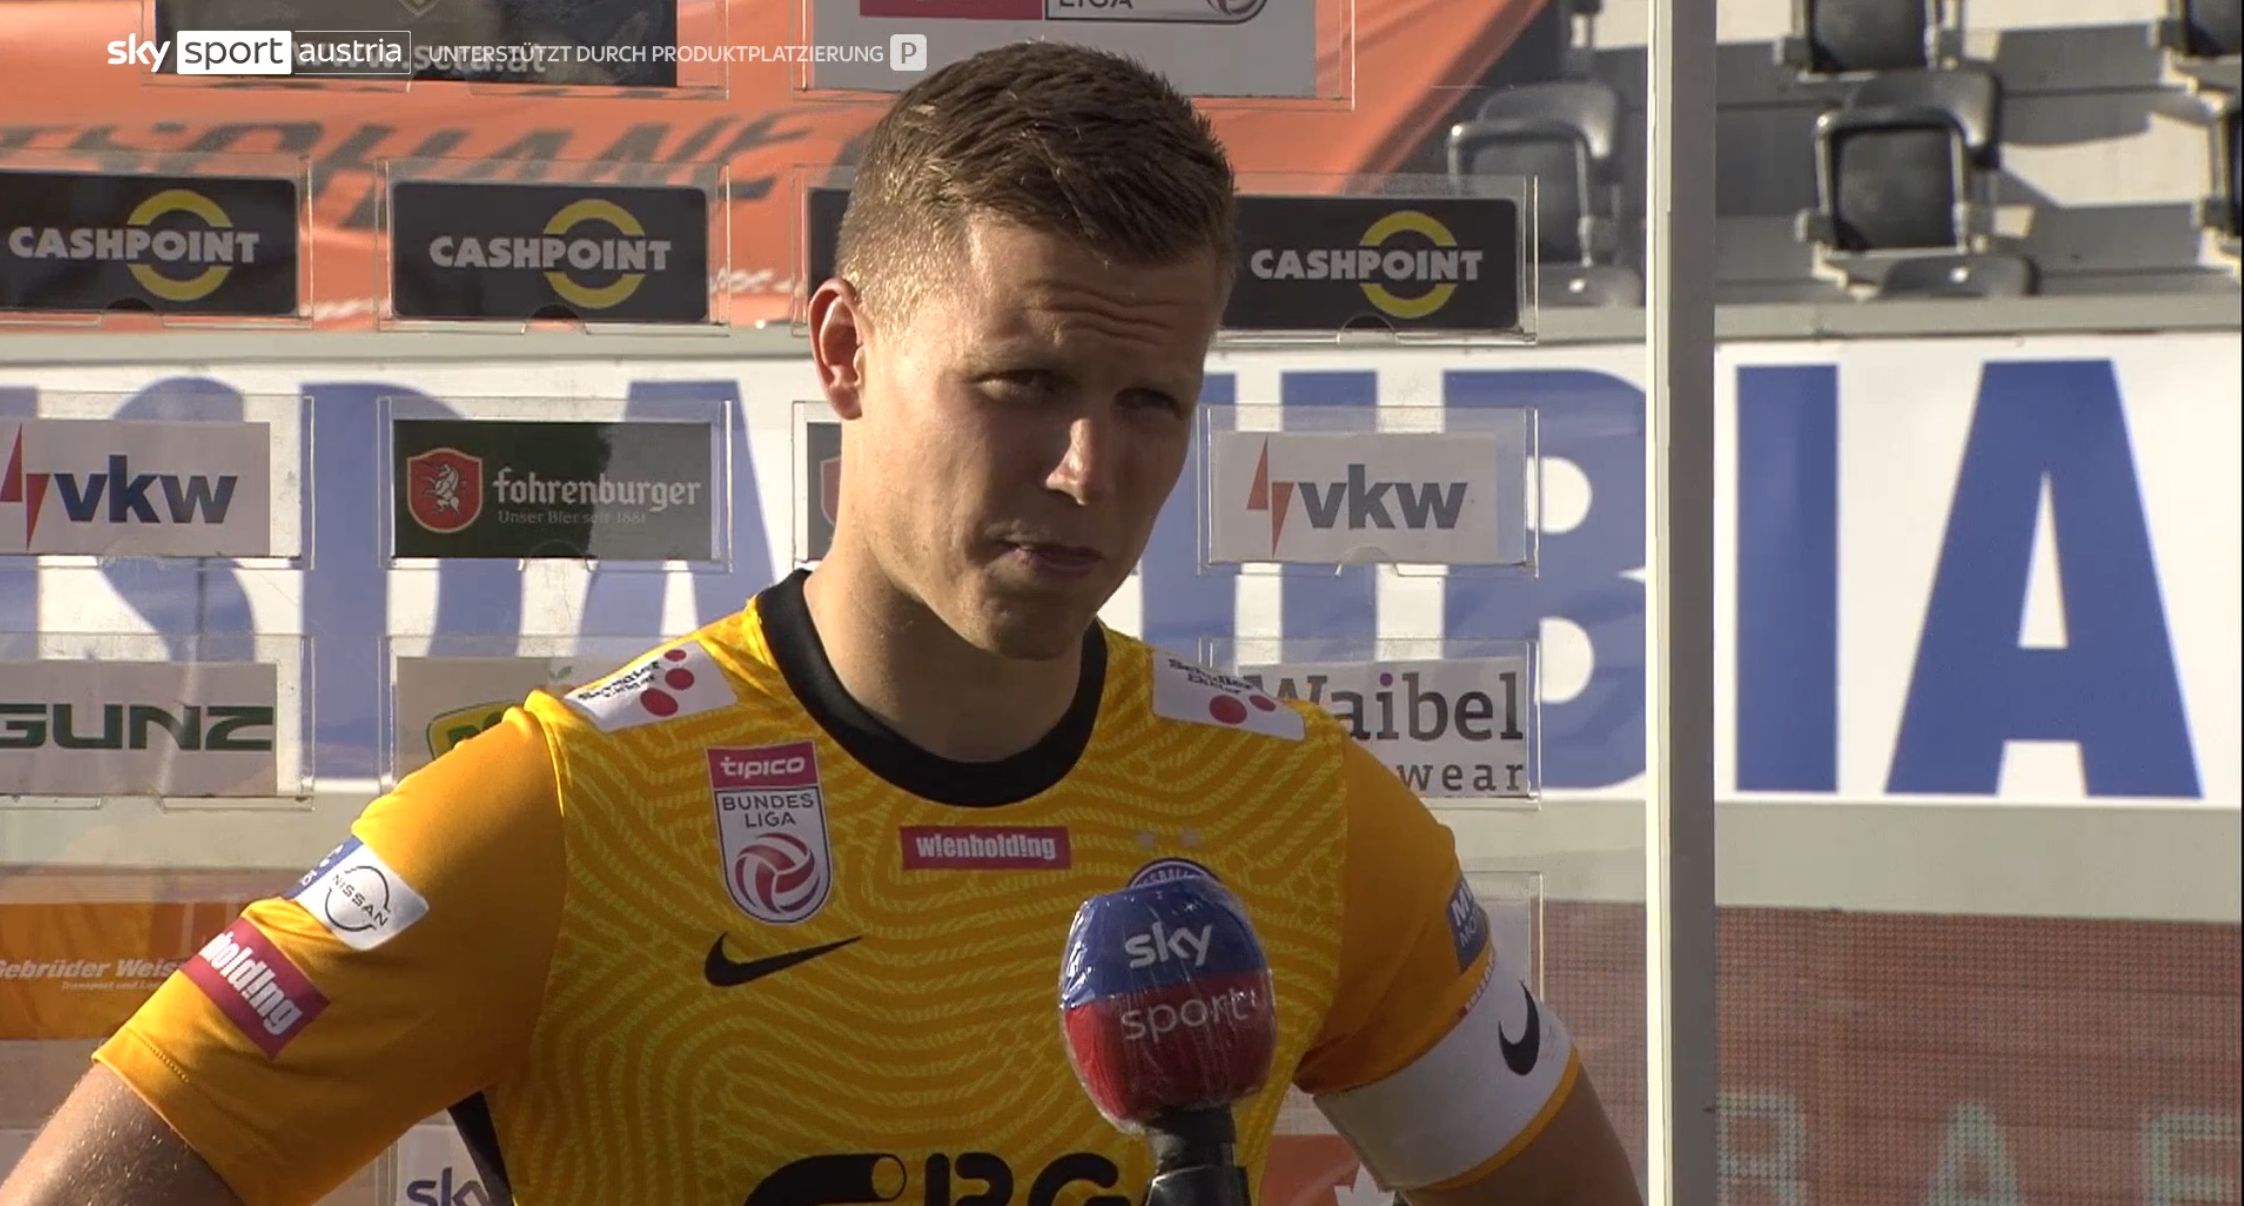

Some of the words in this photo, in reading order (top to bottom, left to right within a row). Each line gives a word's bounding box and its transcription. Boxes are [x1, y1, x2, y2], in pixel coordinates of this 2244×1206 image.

[8, 227, 259, 264] CASHPOINT
[429, 235, 671, 271] CASHPOINT
[1250, 248, 1484, 281] CASHPOINT
[54, 455, 238, 523] vkw
[493, 467, 702, 512] fohrenburger
[1298, 464, 1468, 529] vkw
[498, 511, 543, 524] Unser
[549, 511, 577, 524] Bier
[720, 756, 805, 779] tipico
[722, 793, 814, 811] BUNDES
[745, 812, 796, 828] LIGA
[916, 834, 1056, 860] wienholding
[333, 873, 389, 928] NISSAN
[1125, 921, 1213, 968] sky
[1121, 988, 1249, 1044] sport
